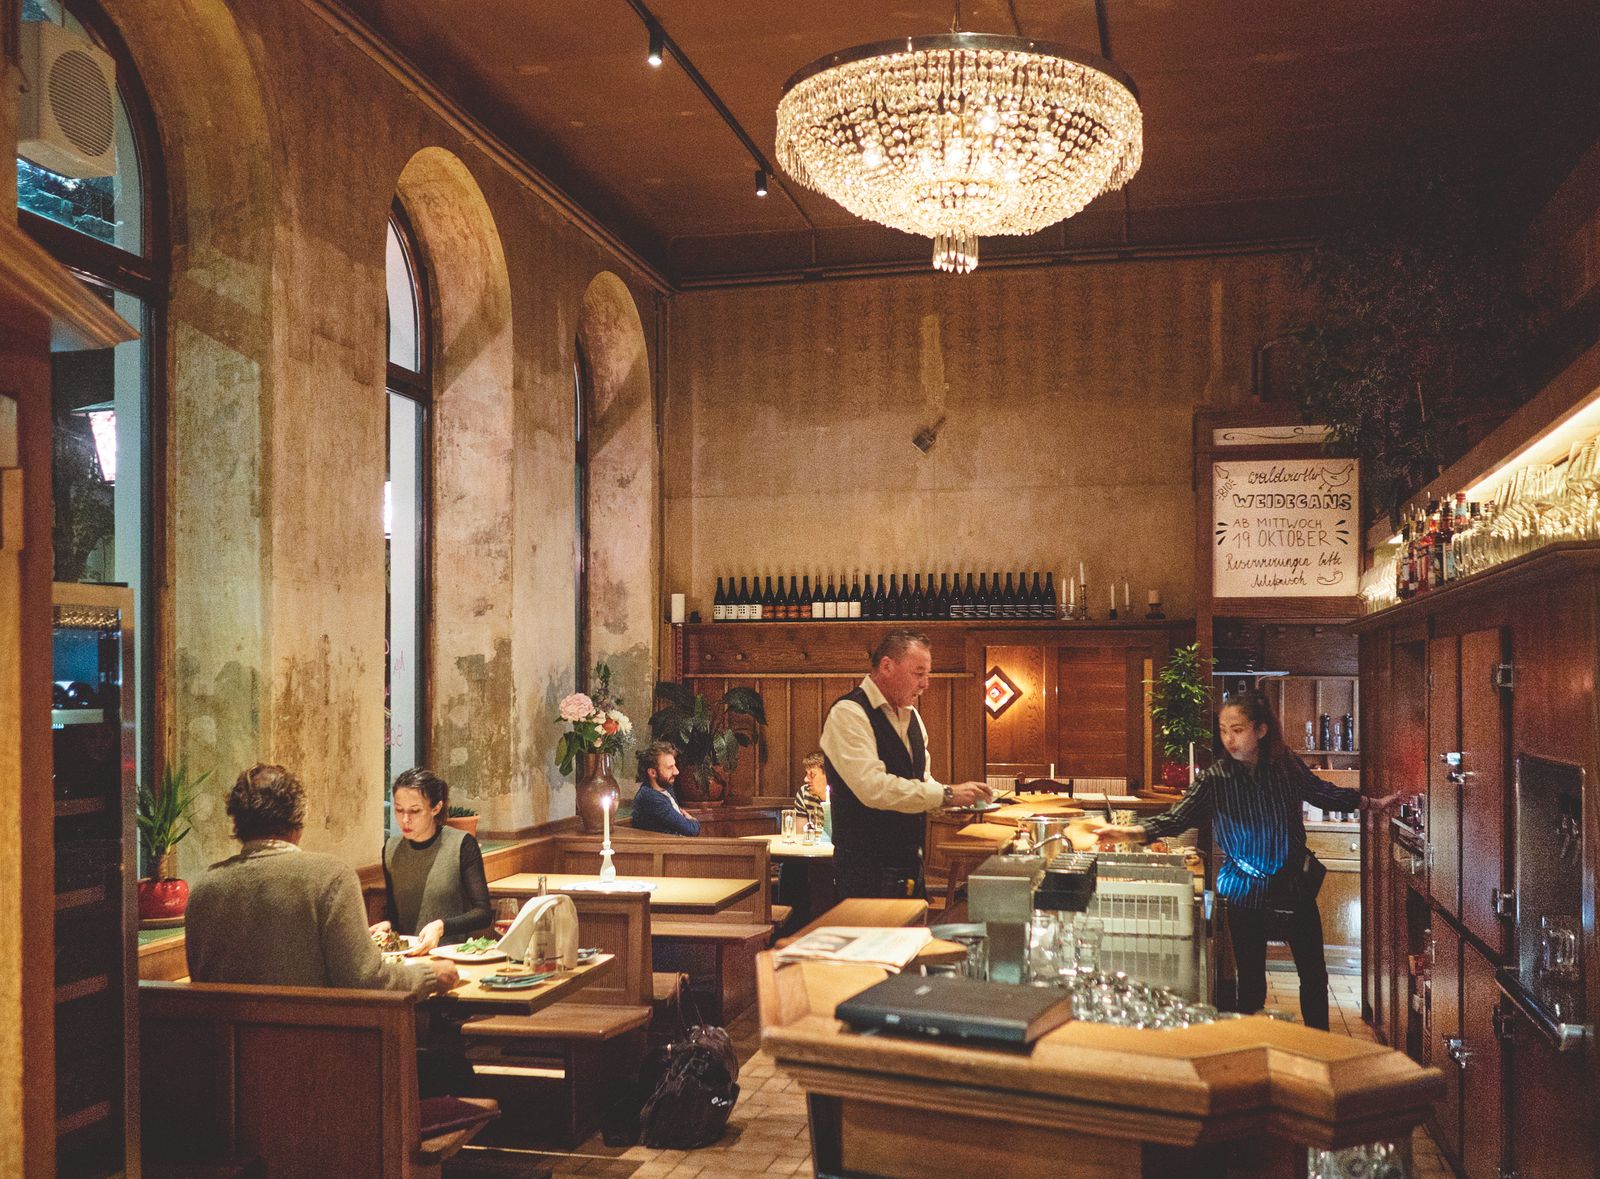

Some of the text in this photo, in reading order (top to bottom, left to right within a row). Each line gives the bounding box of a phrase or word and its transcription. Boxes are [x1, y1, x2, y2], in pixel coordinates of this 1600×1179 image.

[1218, 482, 1232, 497] BIO
[1232, 493, 1352, 511] WEIDEGANS
[1232, 517, 1322, 529] AB MITTWOCH
[1232, 529, 1331, 549] 19 OKTOBER
